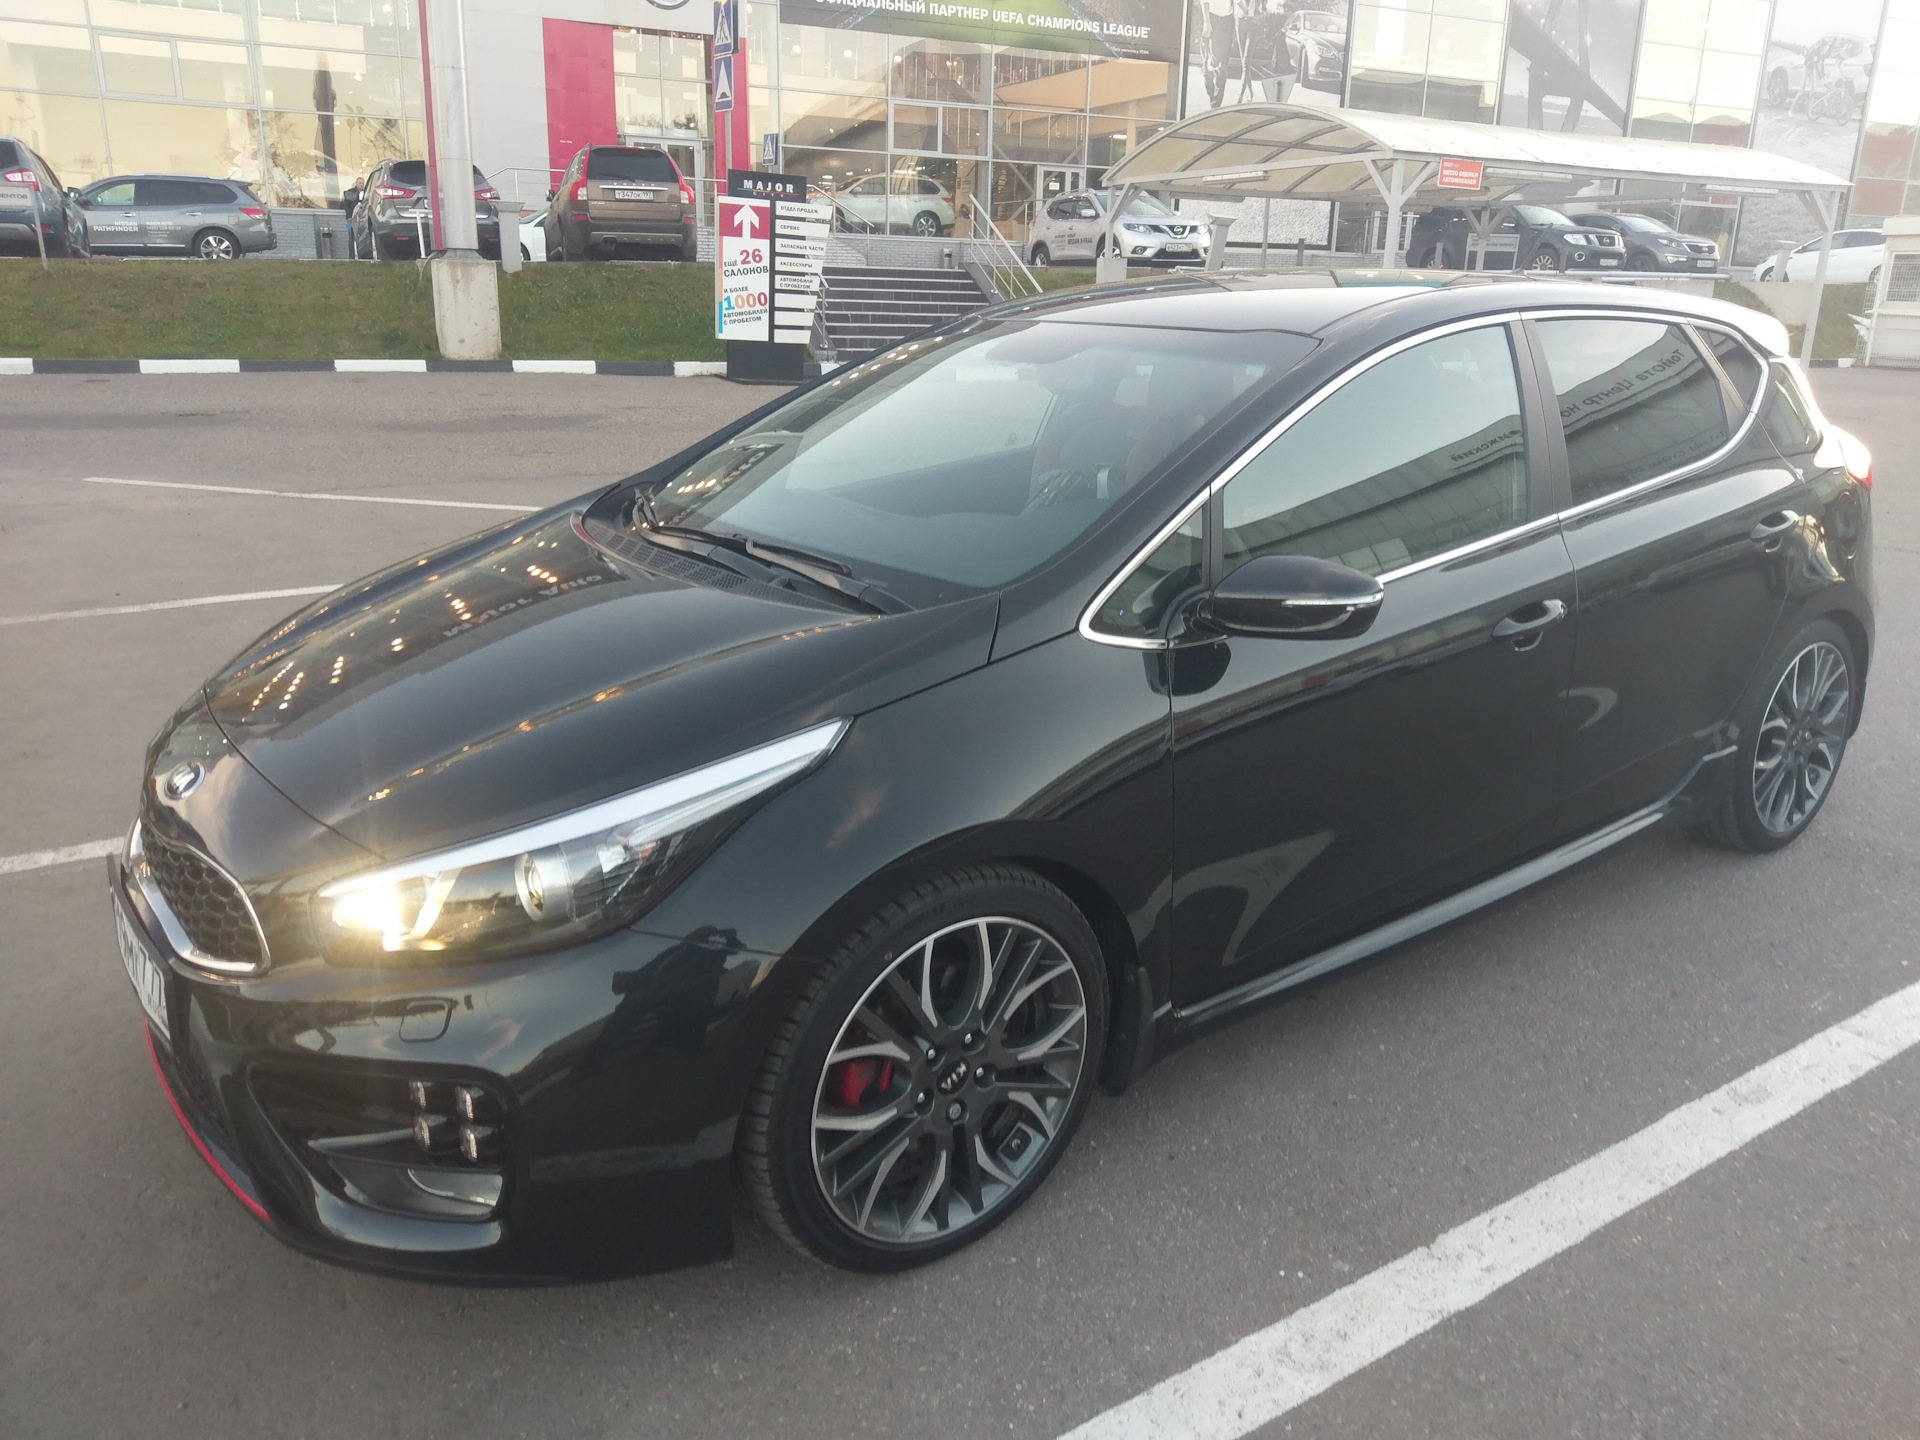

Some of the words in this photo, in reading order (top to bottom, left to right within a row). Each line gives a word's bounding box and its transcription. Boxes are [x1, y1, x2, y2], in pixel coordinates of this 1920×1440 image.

[929, 3, 989, 21] ПАРТНЕР
[992, 10, 1025, 25] UEFA
[1027, 14, 1100, 33] CHAMPIONS
[743, 179, 794, 193] MAJOR
[723, 259, 738, 267] ЕЩЁ
[740, 248, 763, 265] 26
[723, 265, 769, 278] САЛОНОВ
[723, 291, 768, 311] 1000
[723, 307, 768, 318] АВТОМОБИЛЕЙ
[729, 316, 762, 325] ПРОБЕГОМ
